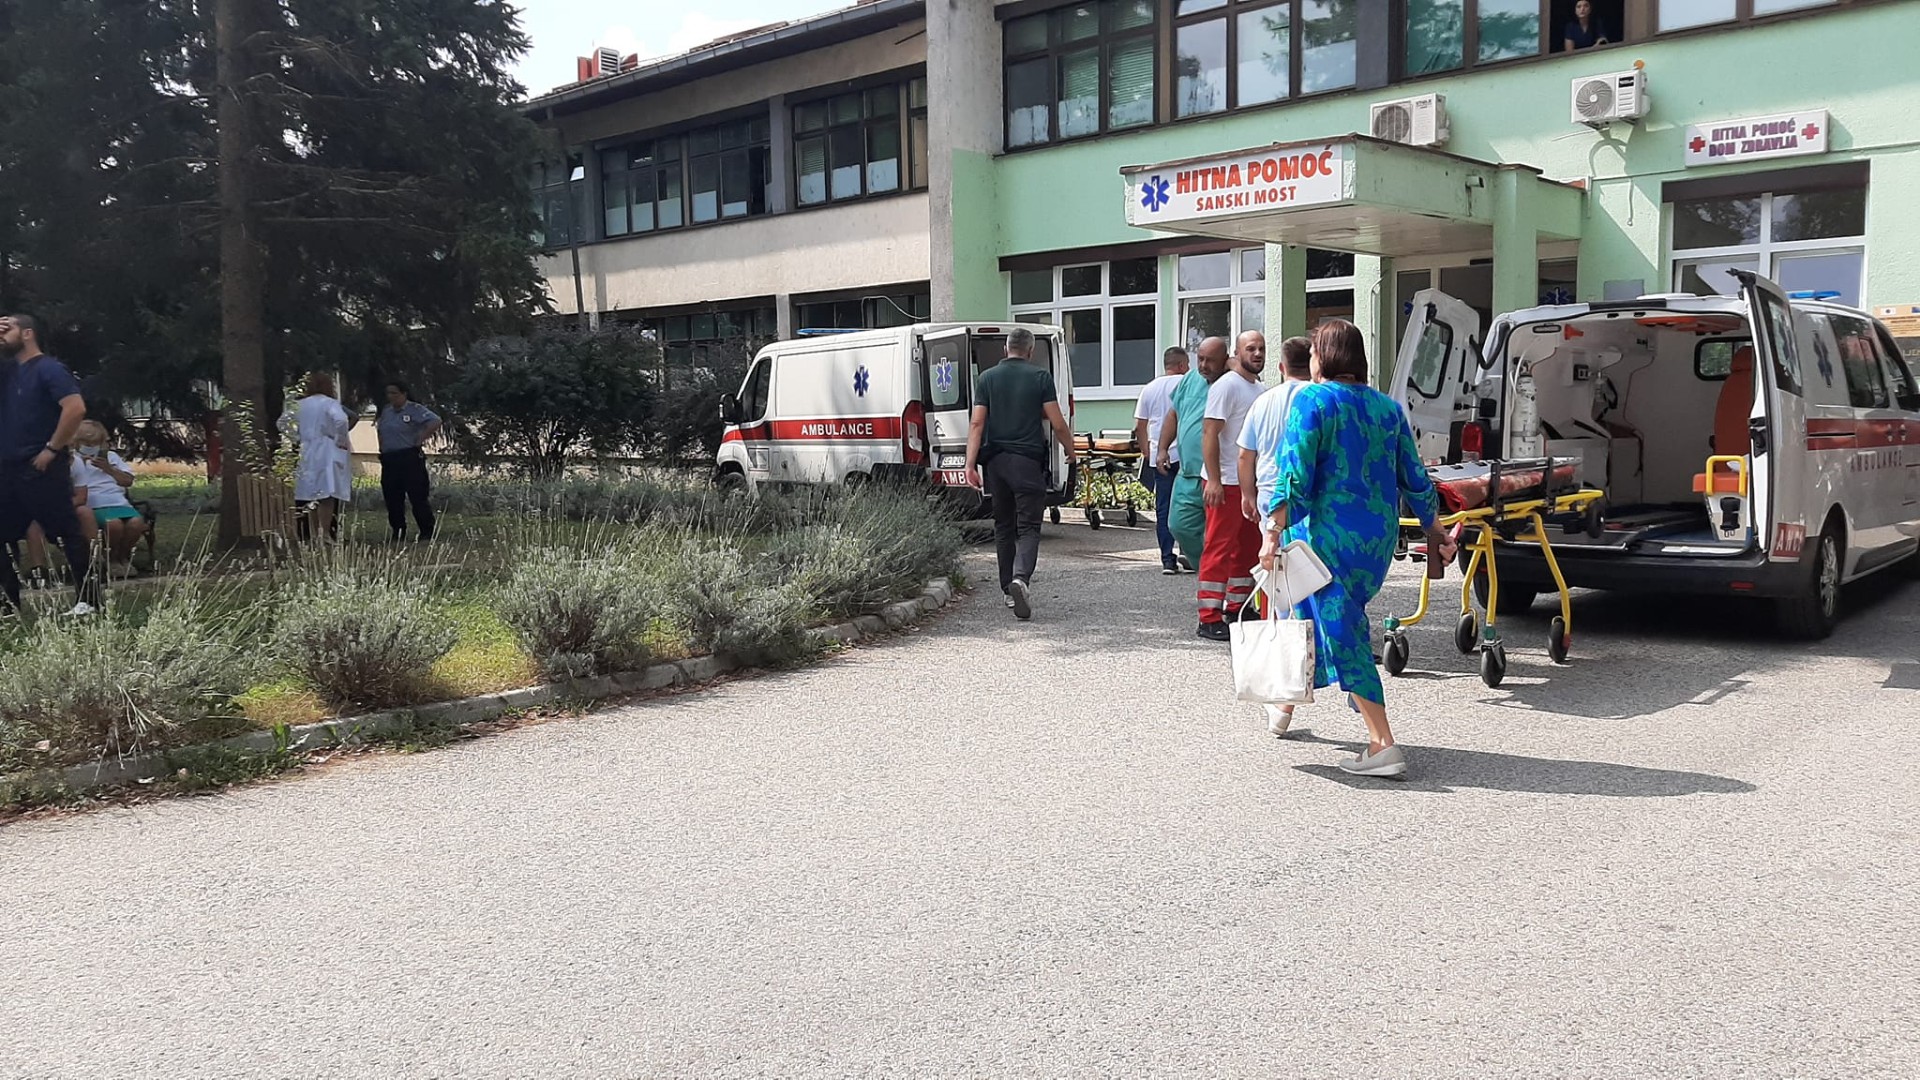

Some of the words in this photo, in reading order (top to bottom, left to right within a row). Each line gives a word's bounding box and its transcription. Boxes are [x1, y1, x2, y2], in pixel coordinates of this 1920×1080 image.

[1712, 125, 1747, 142] HITNA
[1752, 117, 1796, 137] POMOĆ
[1709, 142, 1736, 157] DOM
[1176, 164, 1241, 195] HITNA
[1247, 144, 1333, 185] POMOĆ
[1196, 193, 1249, 212] SANSKI
[1254, 186, 1297, 205] MOST
[801, 423, 873, 436] AMBULANCE
[1850, 449, 1903, 473] AMBULANCE
[942, 471, 966, 485] AMB
